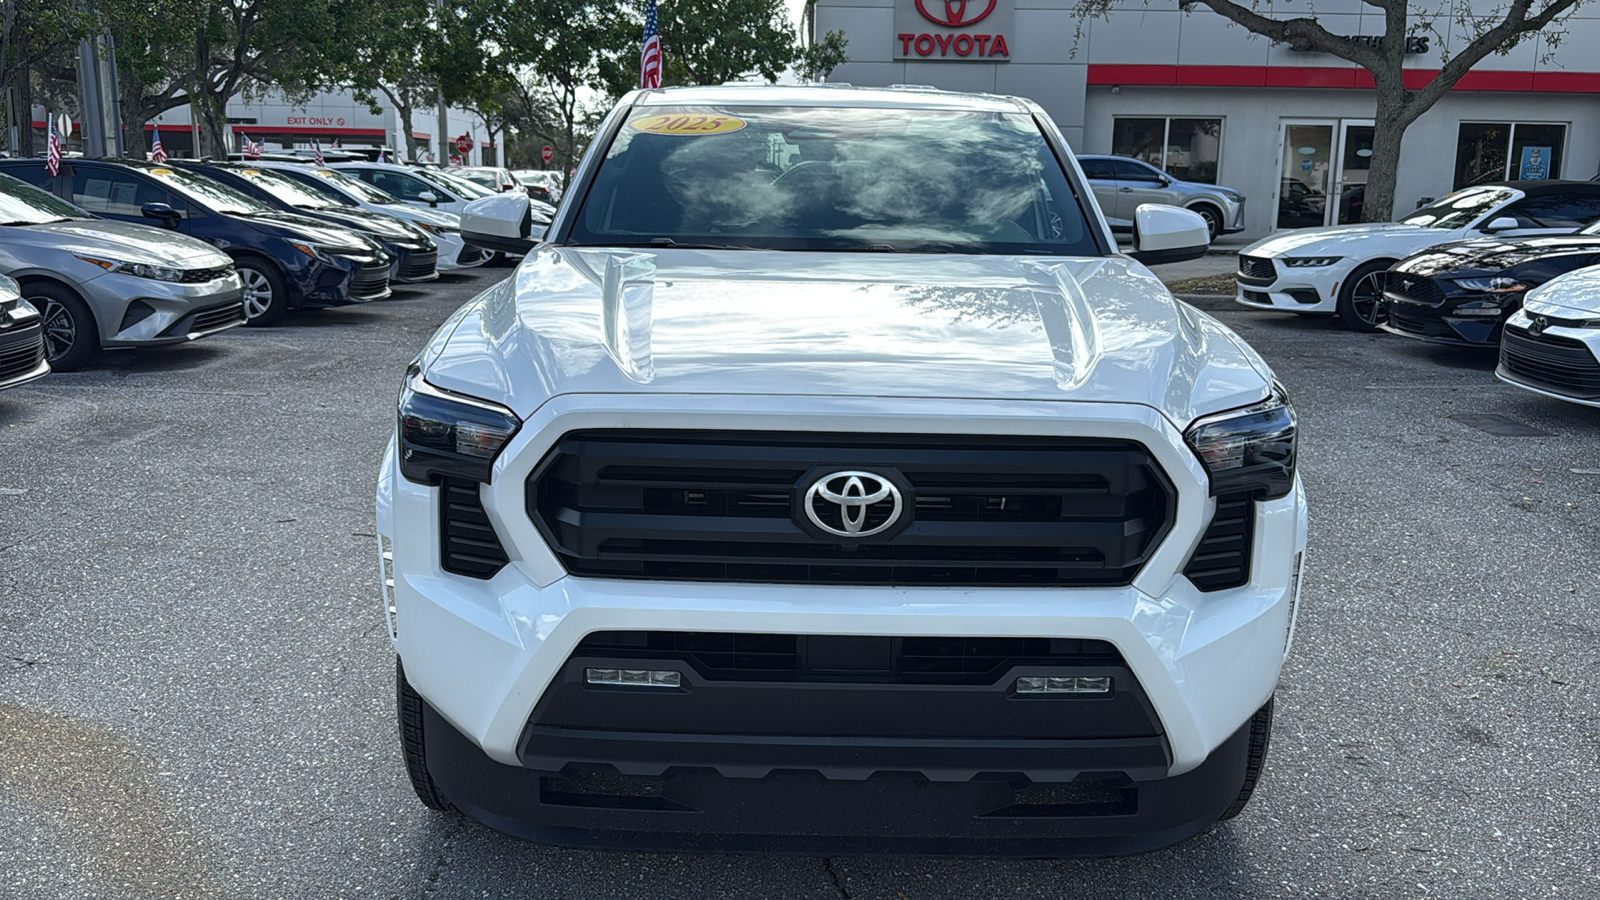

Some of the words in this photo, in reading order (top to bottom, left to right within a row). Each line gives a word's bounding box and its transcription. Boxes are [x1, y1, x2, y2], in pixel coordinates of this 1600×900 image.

[898, 33, 1009, 57] TOYOTA
[287, 116, 306, 125] EXIT
[309, 117, 333, 126] ONLY
[645, 116, 728, 131] 2025
